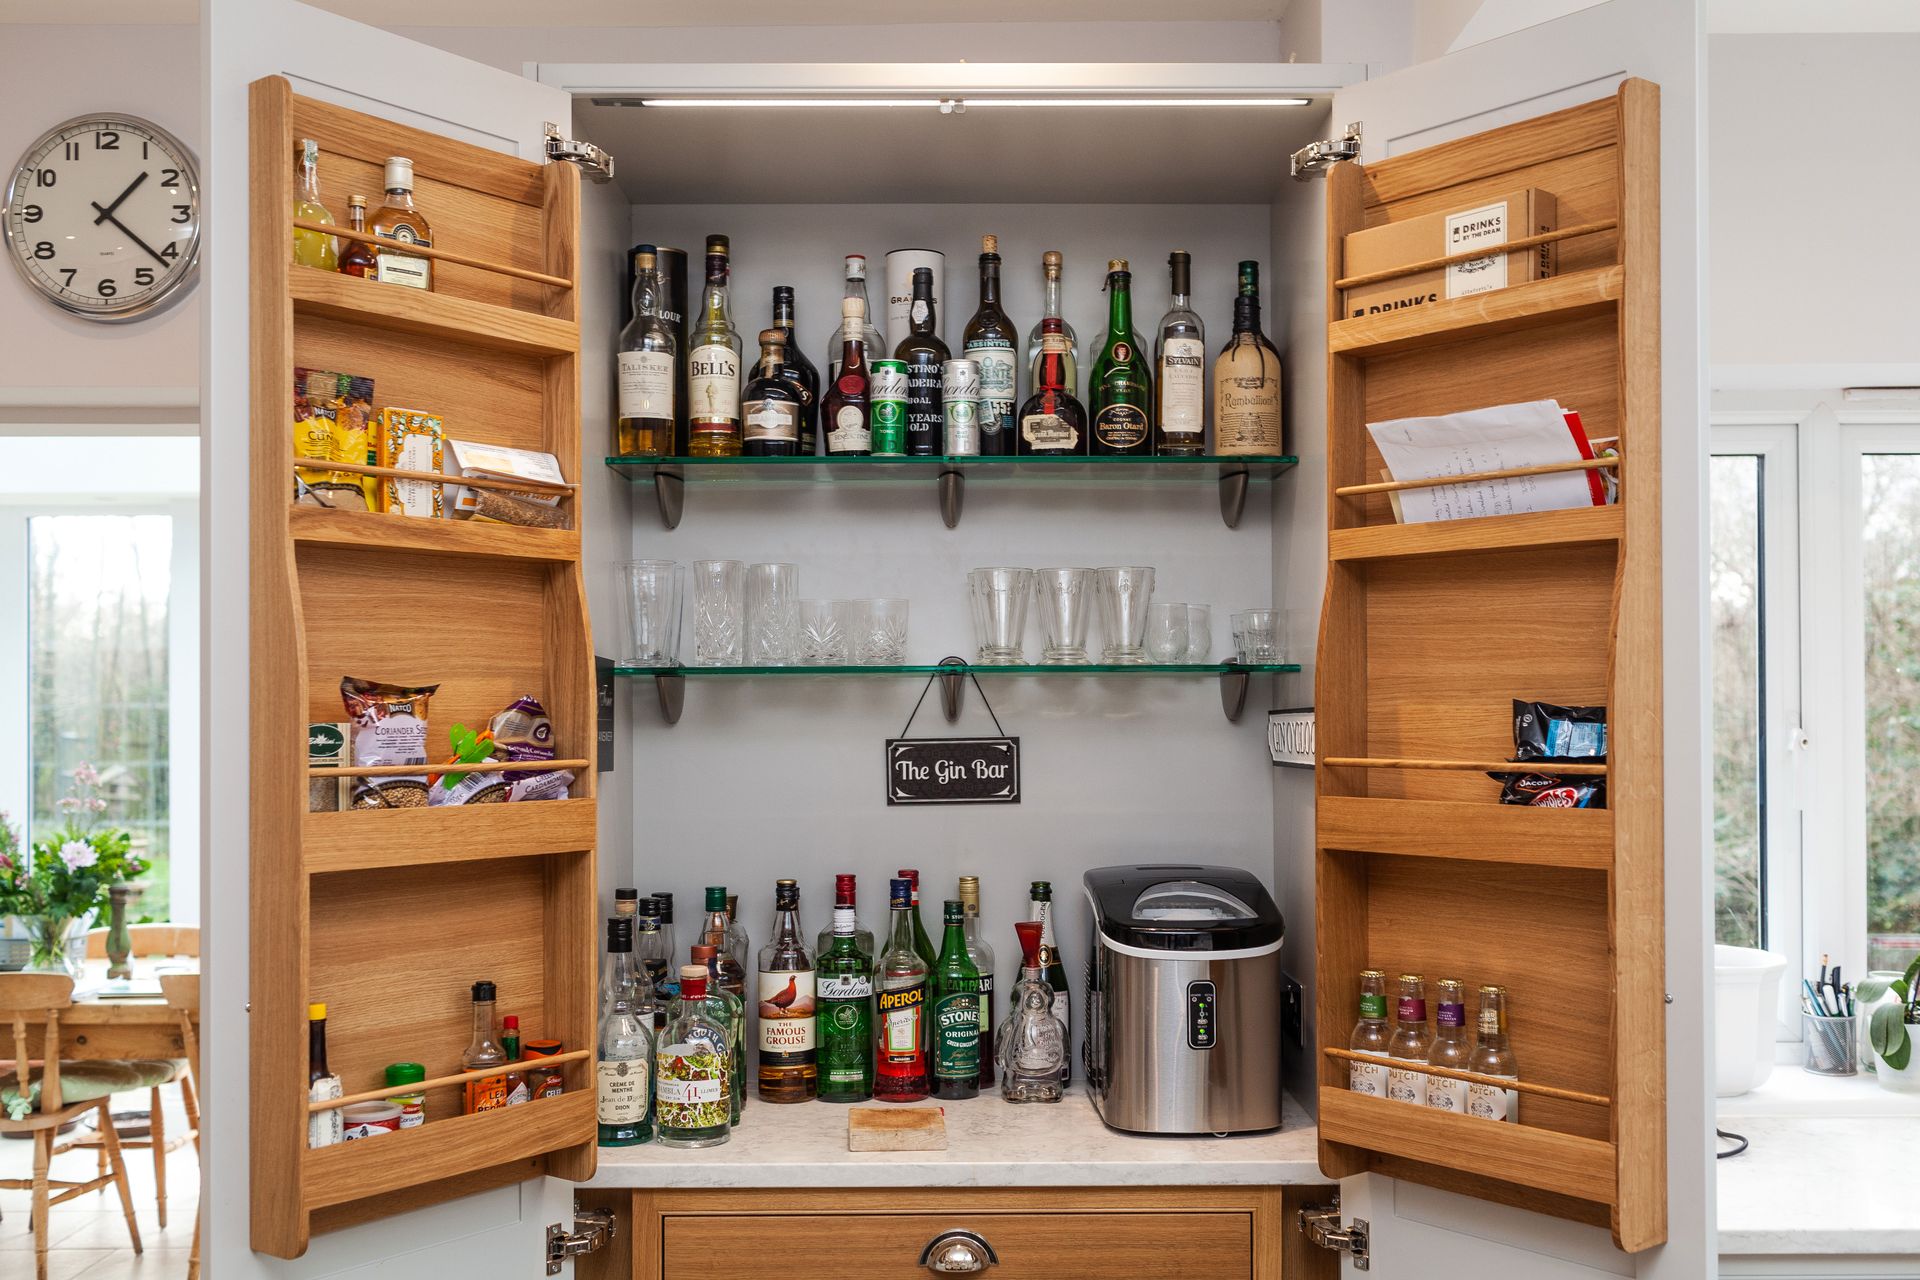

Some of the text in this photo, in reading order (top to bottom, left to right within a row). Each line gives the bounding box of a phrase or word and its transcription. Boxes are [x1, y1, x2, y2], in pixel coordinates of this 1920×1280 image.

[96, 132, 120, 150] 12
[66, 142, 79, 161] 11
[143, 142, 148, 160] 1
[37, 169, 56, 187] 10
[161, 169, 179, 187] 2
[23, 205, 43, 223] 9
[170, 205, 191, 223] 3
[1463, 217, 1501, 233] DRINKS
[1483, 227, 1501, 236] DRAM
[34, 241, 56, 260] 8
[161, 242, 179, 259] 4
[59, 268, 77, 287] 7
[134, 268, 155, 286] 5
[98, 279, 117, 297] 6
[622, 363, 669, 372] TALISKER
[691, 360, 735, 377] BELL'S
[908, 364, 944, 374] STINO'S
[908, 378, 943, 389] ADEIRA
[909, 414, 943, 423] YEARS
[1123, 422, 1144, 430] Otard
[909, 423, 930, 432] OLD
[389, 703, 412, 713] NATCO
[375, 725, 414, 736] CORIANDER
[895, 759, 1009, 784] The Gin Bar
[822, 980, 870, 997] Gordon's
[880, 990, 923, 1010] APEROL
[766, 1026, 806, 1036] FAMOUS
[766, 1036, 806, 1045] GROUSE
[1350, 1064, 1379, 1074] DUTCH
[1389, 1069, 1419, 1080] DUTCH
[1427, 1075, 1457, 1089] DUTCH
[489, 1089, 505, 1099] LEA
[1470, 1086, 1496, 1096] DUTCH
[600, 1095, 616, 1104] Jean
